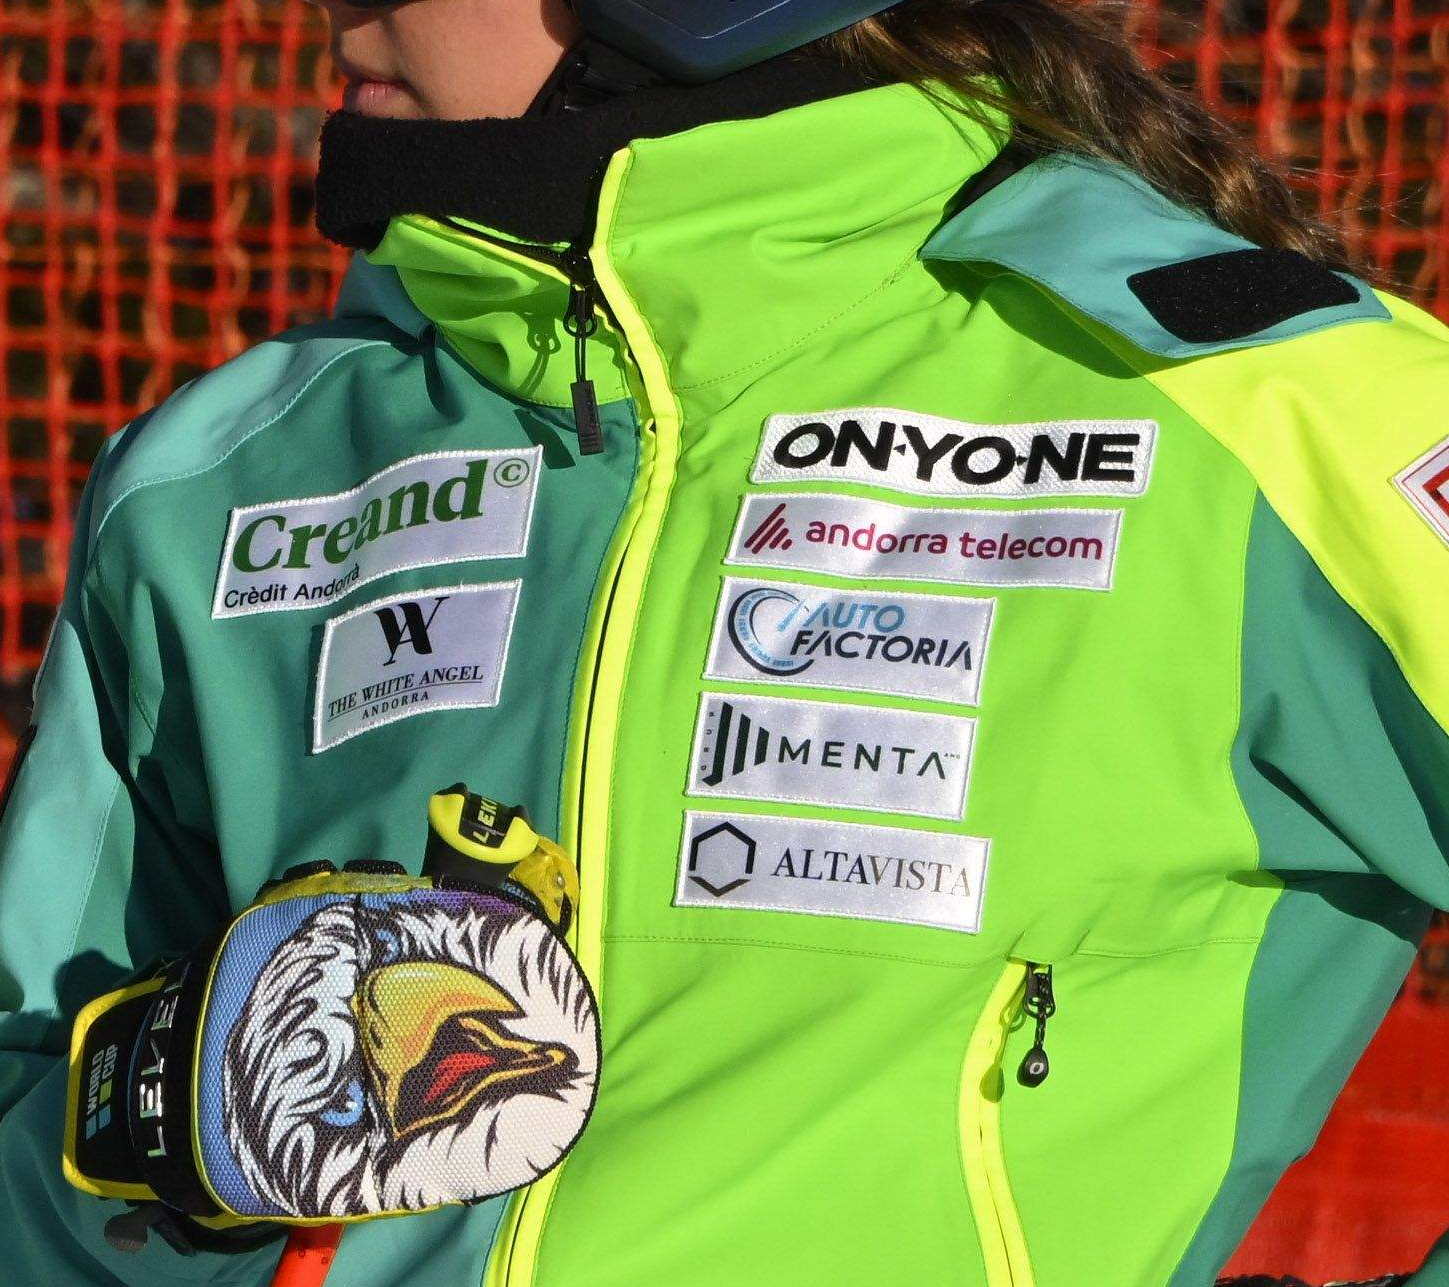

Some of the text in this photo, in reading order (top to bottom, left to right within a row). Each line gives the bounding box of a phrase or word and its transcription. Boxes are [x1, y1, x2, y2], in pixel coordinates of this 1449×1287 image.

[806, 517, 1103, 562] andorra telecom
[224, 563, 361, 609] Crèdit Andorrà
[804, 598, 906, 634] AUTO
[790, 630, 974, 671] FACTORIA
[328, 665, 484, 718] THE WHITE ANGEL
[362, 691, 430, 720] ANDORRA
[771, 849, 973, 898] ALTAVISTA
[103, 1044, 119, 1080] CUP
[139, 959, 192, 1159] LEVEL
[86, 1049, 104, 1116] WORLD
